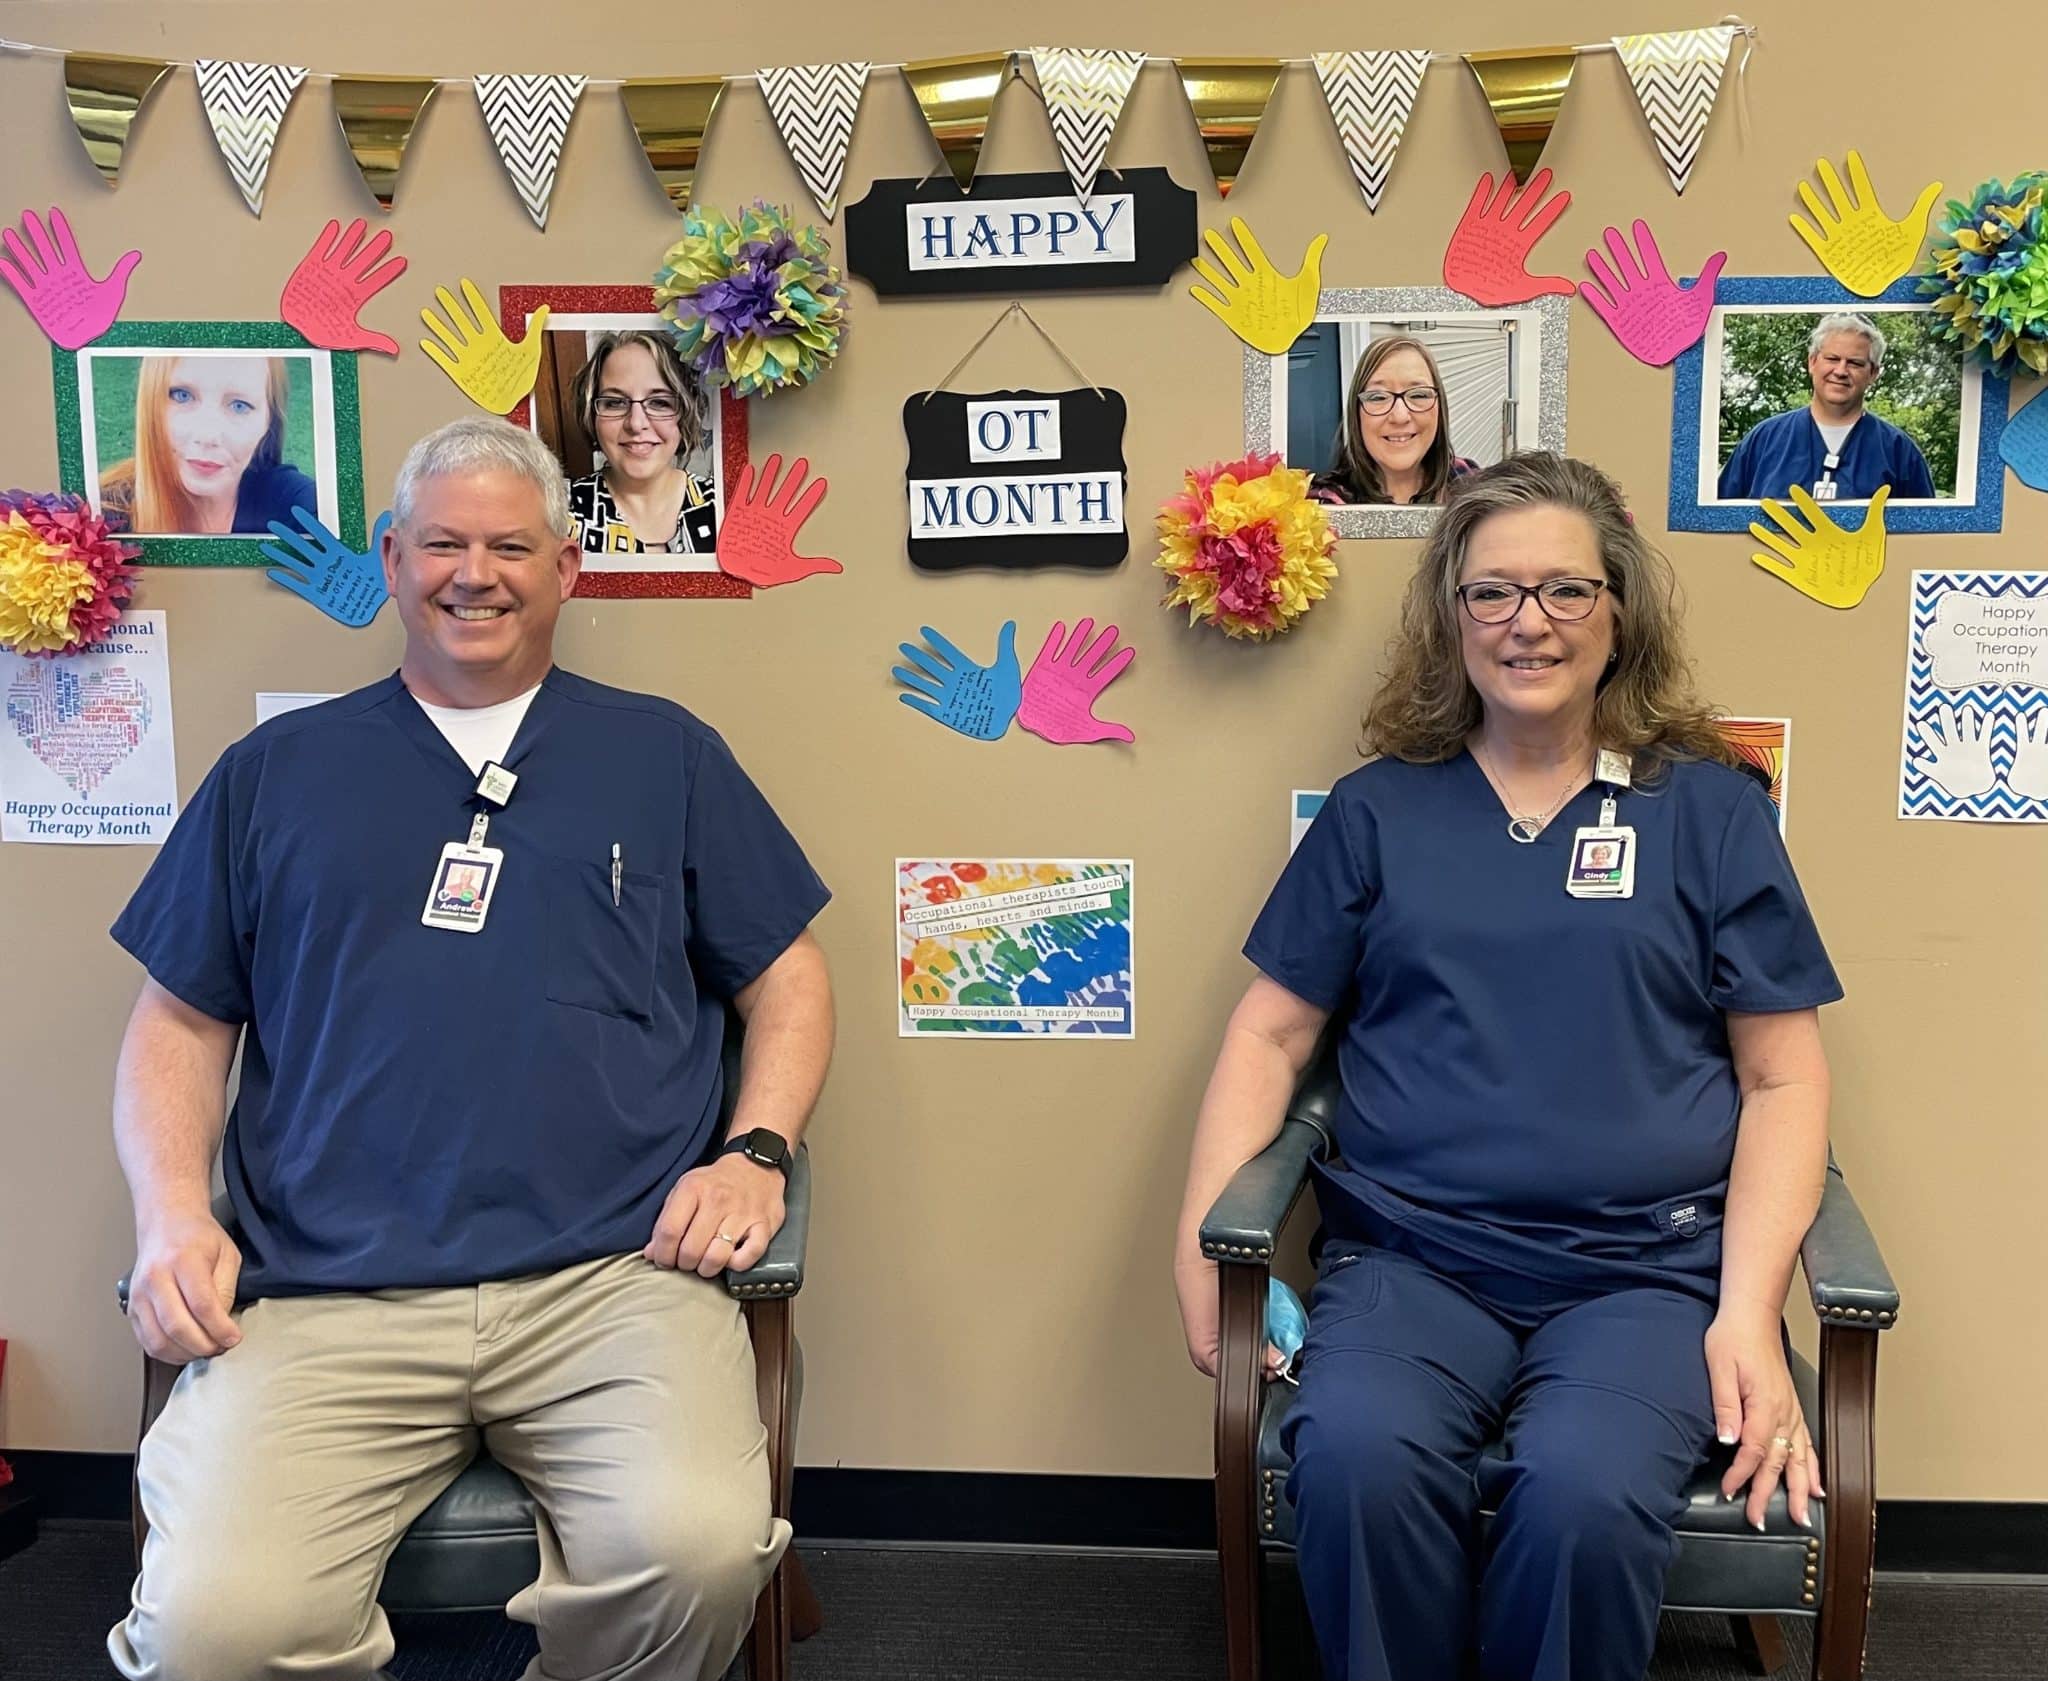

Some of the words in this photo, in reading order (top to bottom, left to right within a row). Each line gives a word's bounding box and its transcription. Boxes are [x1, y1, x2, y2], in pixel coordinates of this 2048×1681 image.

[920, 198, 1127, 261] HAPPY
[978, 409, 1051, 453] OT
[920, 481, 1116, 530] MONTH
[1983, 606, 2035, 621] Happy
[88, 643, 148, 654] cause...
[1976, 642, 2038, 658] Therapy
[1980, 661, 2030, 673] Month
[6, 801, 56, 818] Happy
[62, 803, 172, 819] Occupational
[27, 820, 93, 838] Therapy
[97, 821, 151, 835] Month
[1584, 872, 1609, 880] Cindy
[905, 898, 994, 922] Occupational
[1002, 887, 1076, 905] therapists
[1084, 878, 1121, 892] touch
[925, 921, 967, 935] hands,
[977, 910, 1021, 927] hearts
[1029, 905, 1051, 917] and
[1058, 899, 1103, 912] minds.
[913, 1007, 945, 1017] Happy
[951, 1008, 1028, 1018] Occupational
[1035, 1008, 1080, 1018] Therapy
[1086, 1008, 1120, 1018] Month
